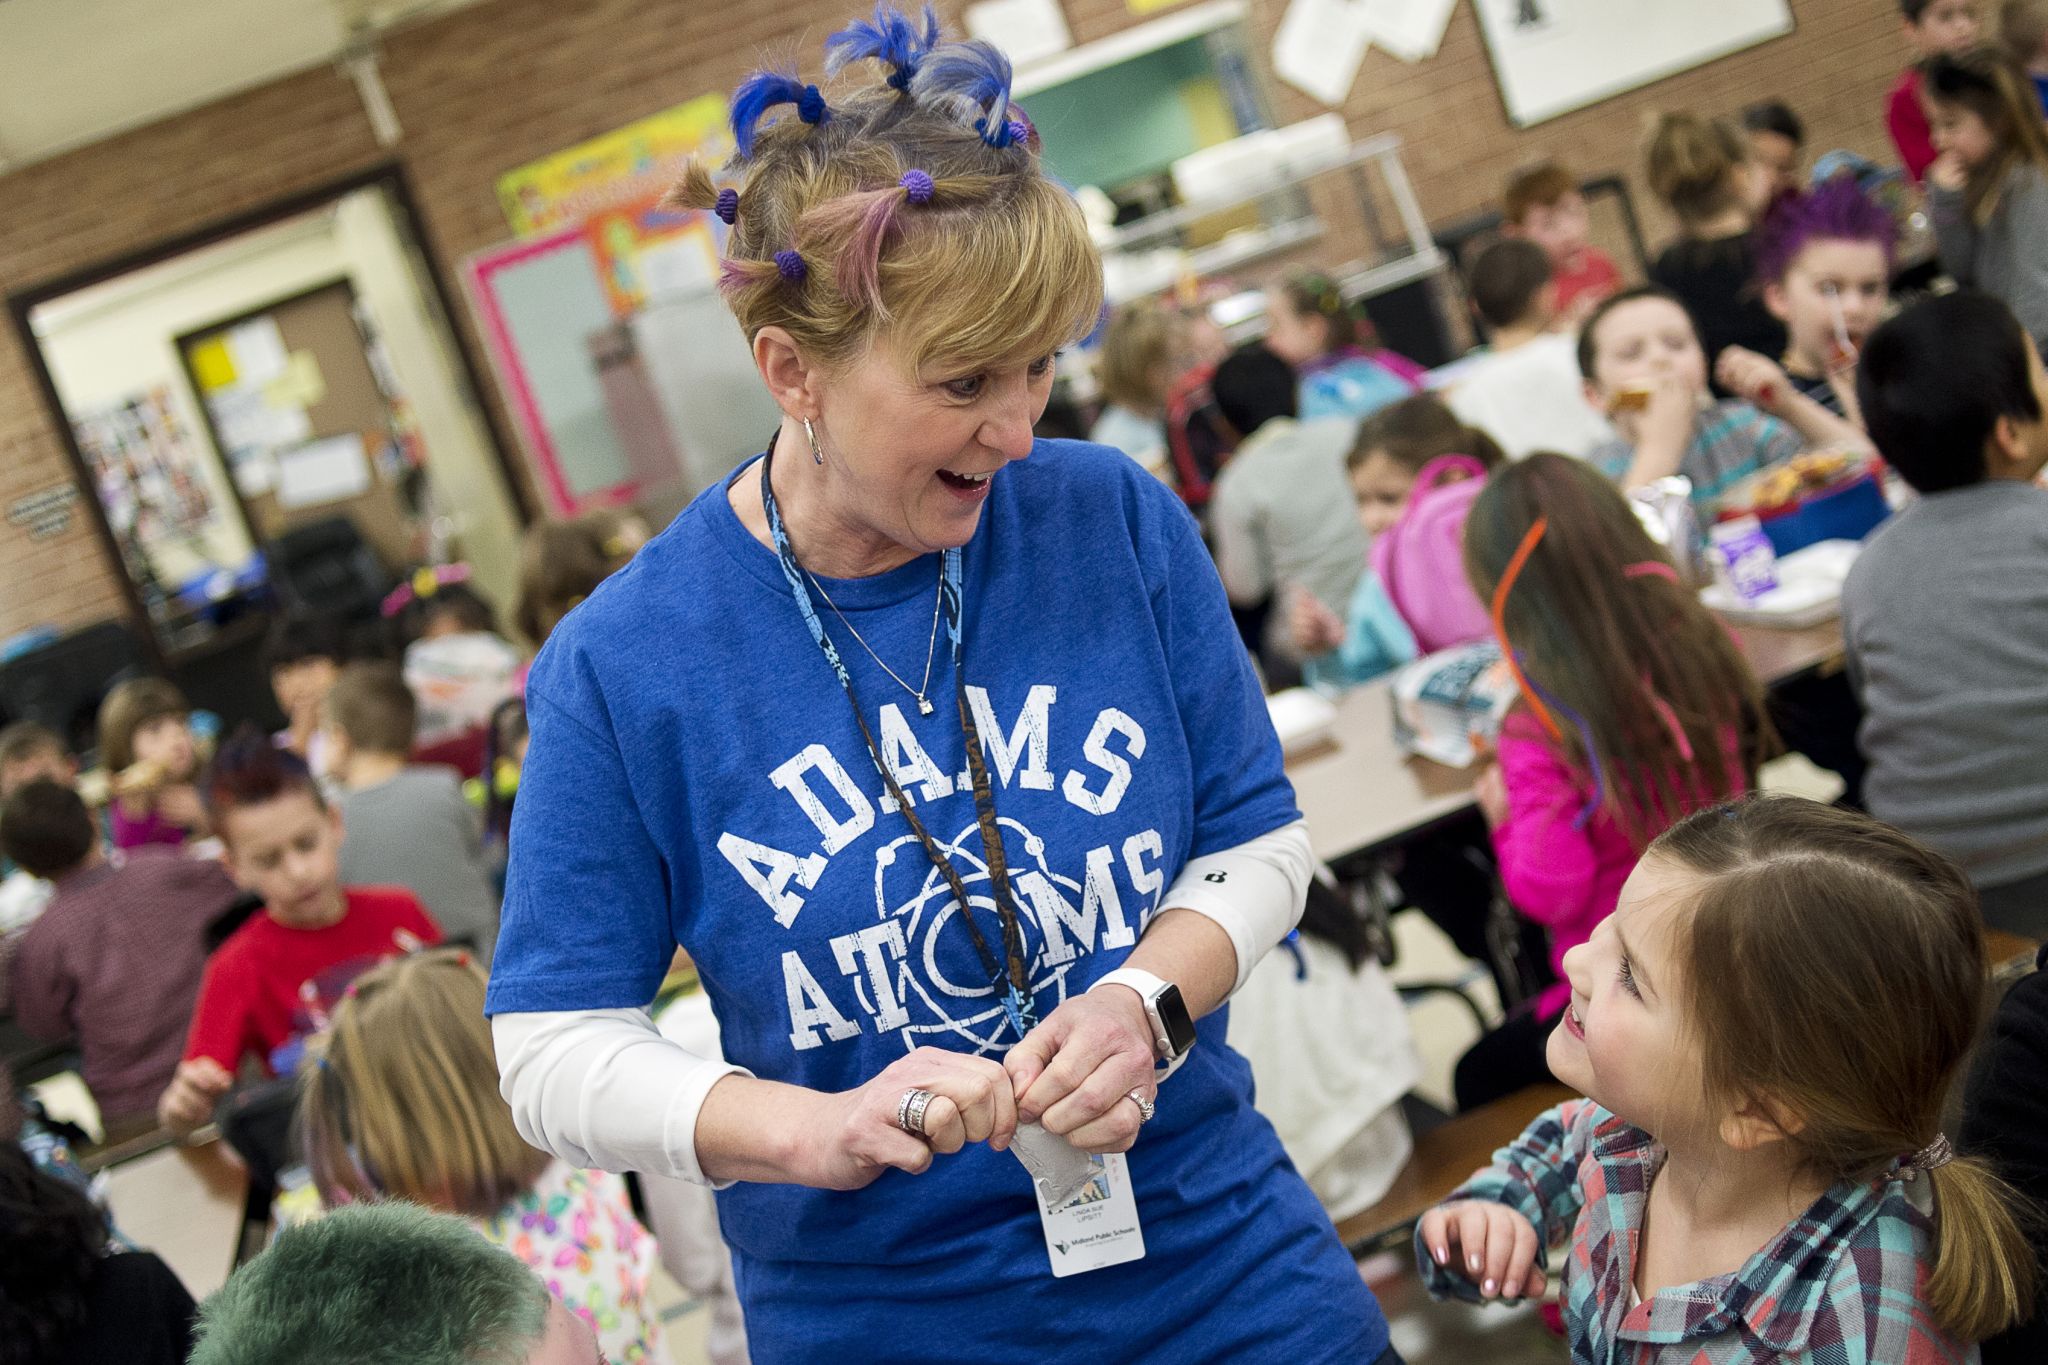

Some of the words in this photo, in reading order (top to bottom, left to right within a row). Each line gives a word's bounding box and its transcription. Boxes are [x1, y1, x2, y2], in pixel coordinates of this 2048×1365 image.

[717, 684, 1147, 928] ADAMS
[781, 828, 1164, 1050] ATOMS
[1072, 1235, 1094, 1246] Midland
[1096, 1232, 1112, 1240] Public
[1113, 1227, 1135, 1236] Schools
